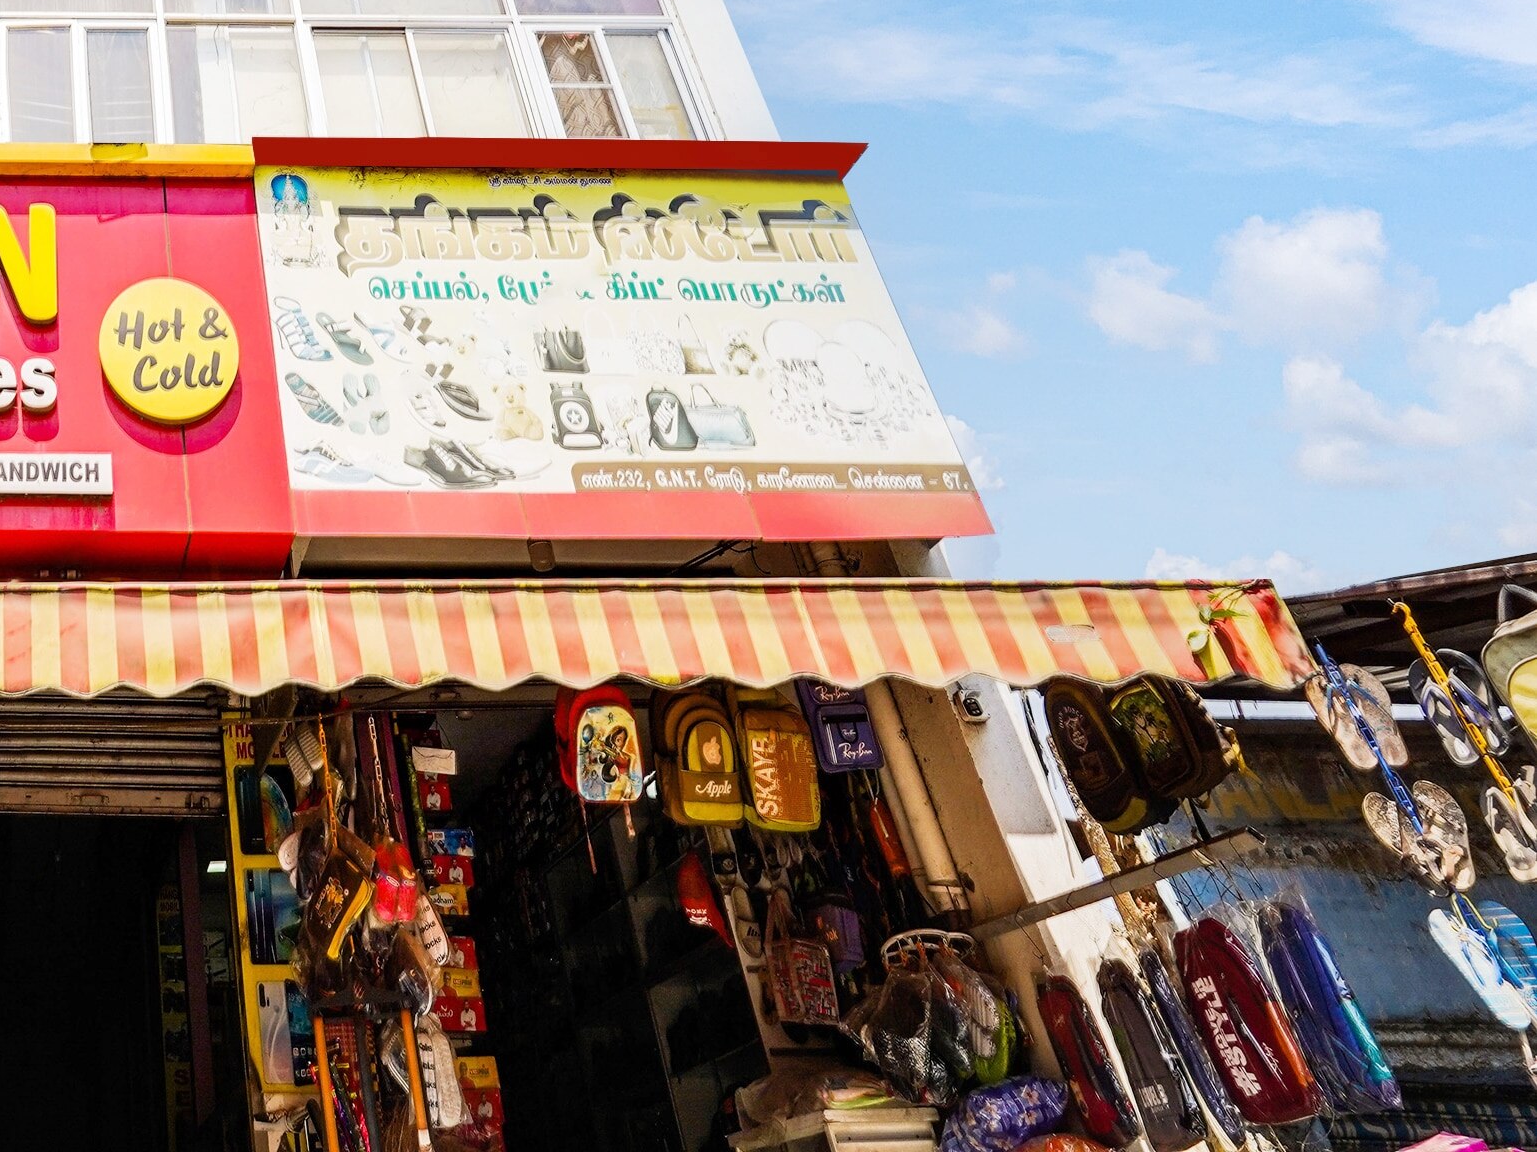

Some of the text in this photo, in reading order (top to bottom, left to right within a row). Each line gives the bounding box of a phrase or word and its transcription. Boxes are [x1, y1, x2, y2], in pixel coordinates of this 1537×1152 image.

[334, 193, 591, 278] தங்கம்
[114, 306, 229, 350] Hot &
[132, 350, 224, 393] Cold
[655, 468, 702, 488] G.N.T.
[695, 779, 732, 797] Apple
